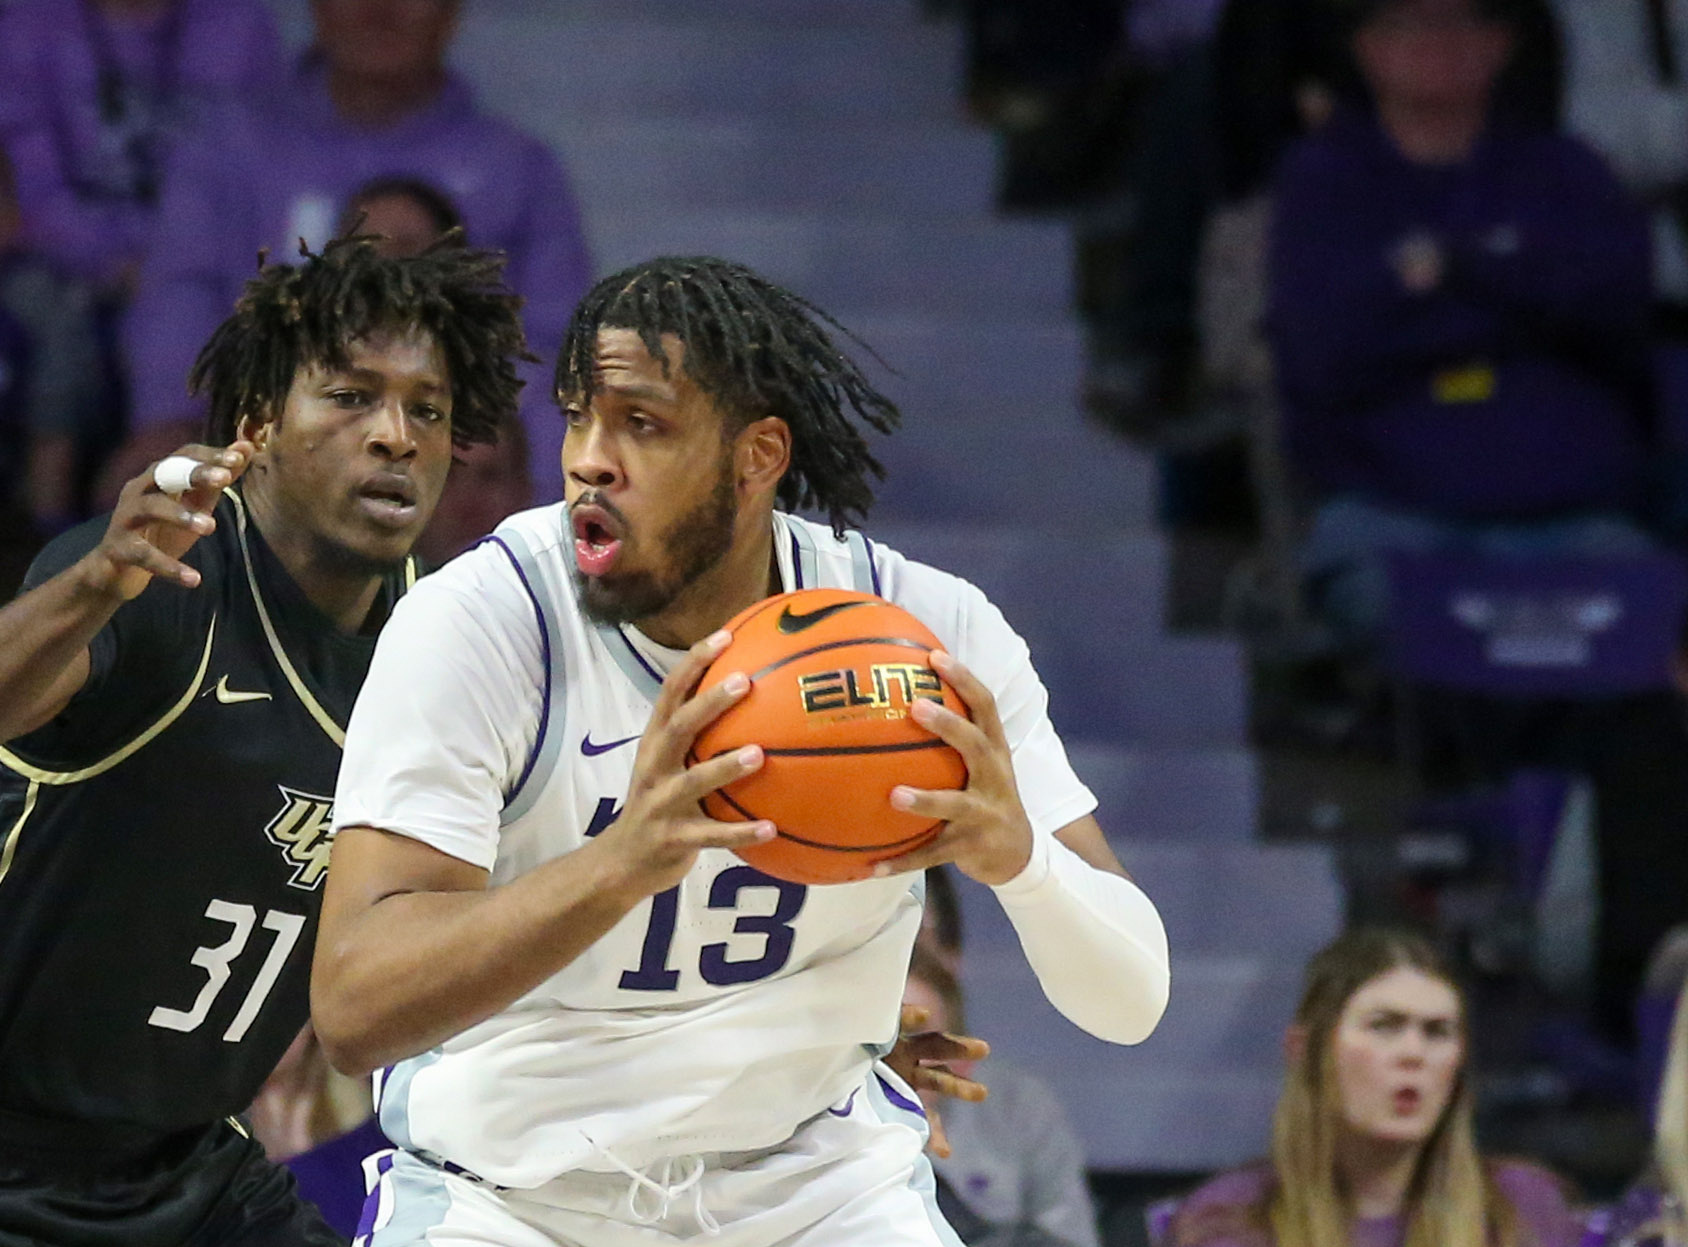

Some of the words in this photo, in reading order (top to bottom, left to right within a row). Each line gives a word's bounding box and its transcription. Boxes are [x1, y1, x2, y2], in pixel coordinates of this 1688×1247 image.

[798, 663, 944, 712] ELITE
[148, 898, 307, 1043] 31
[618, 864, 808, 992] 13
